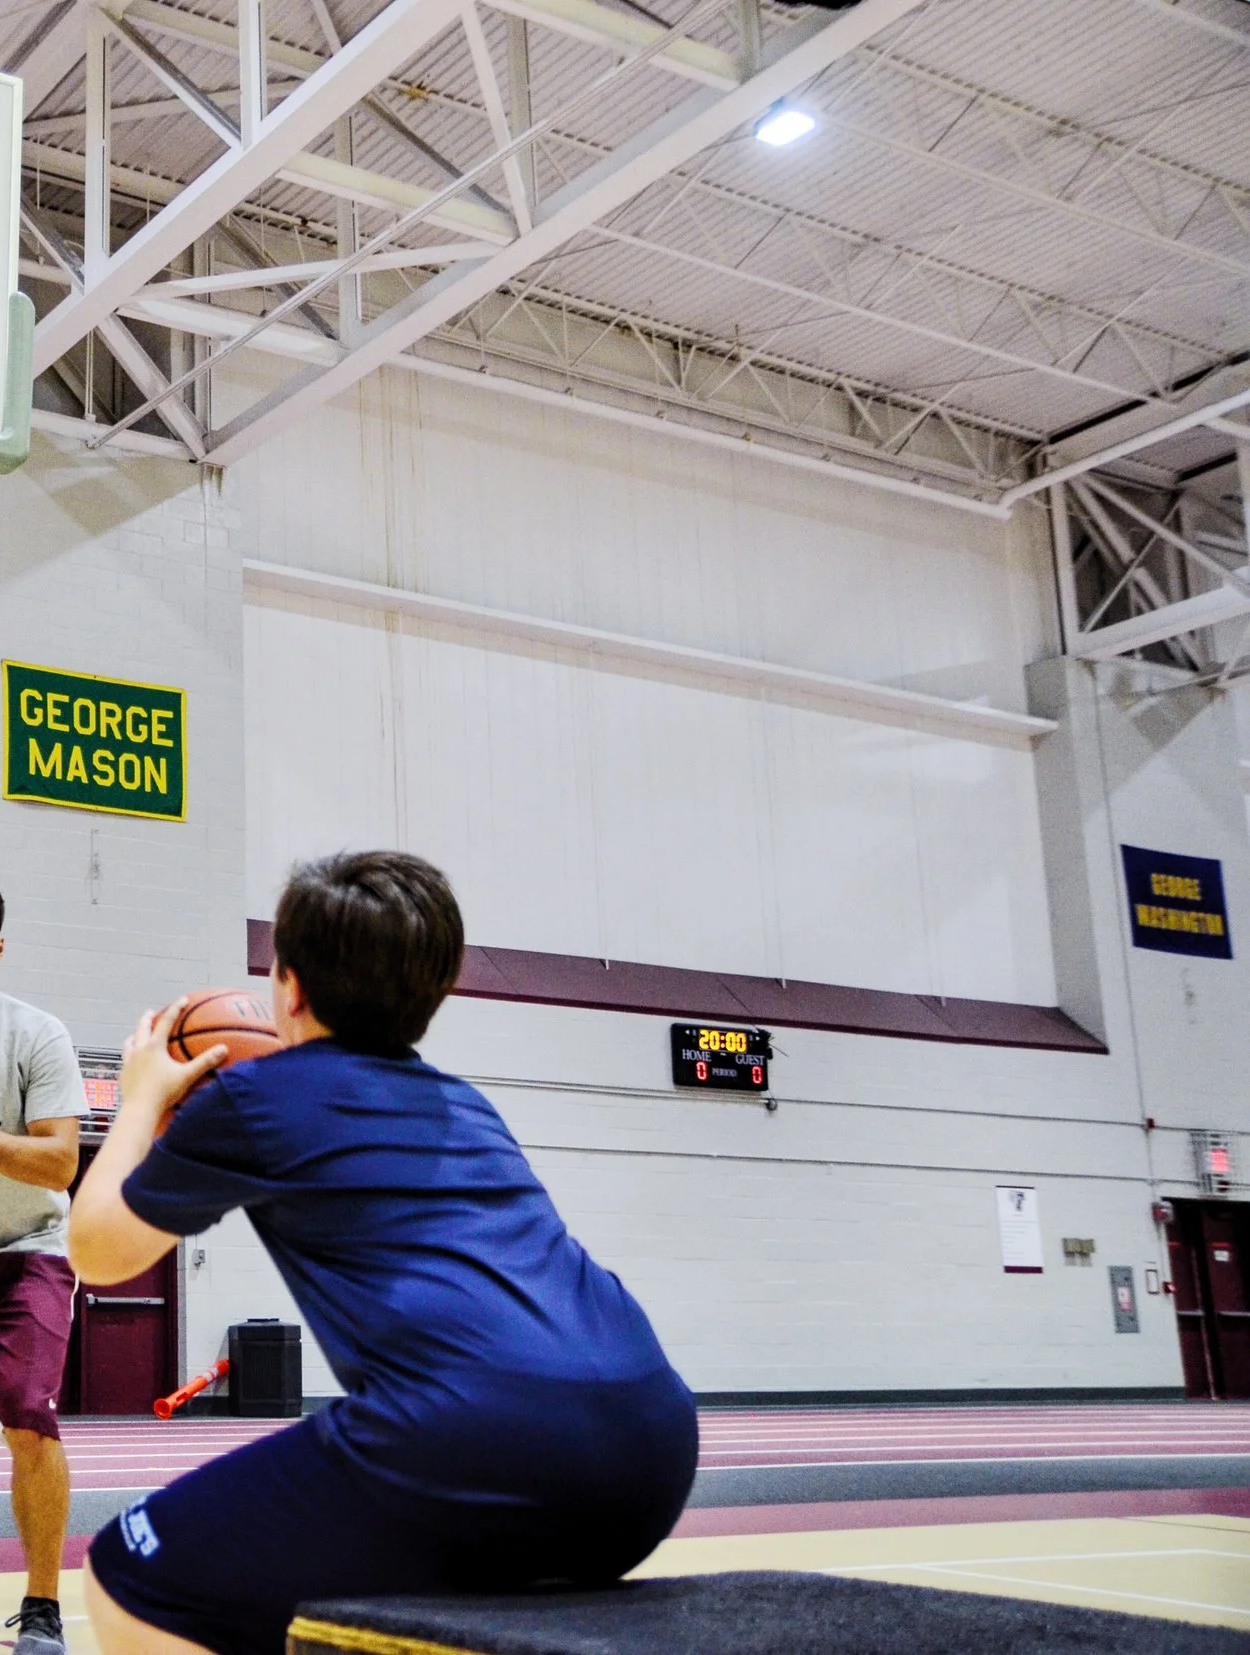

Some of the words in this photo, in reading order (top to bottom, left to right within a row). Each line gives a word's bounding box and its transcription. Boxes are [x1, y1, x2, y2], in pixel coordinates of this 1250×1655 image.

[20, 688, 174, 748] GEORGE
[28, 737, 167, 795] MASON
[699, 1029, 747, 1053] 20:00
[682, 1048, 712, 1062] HOME
[735, 1053, 765, 1066] GUEST
[696, 1061, 707, 1080] 0
[752, 1065, 762, 1085] 0
